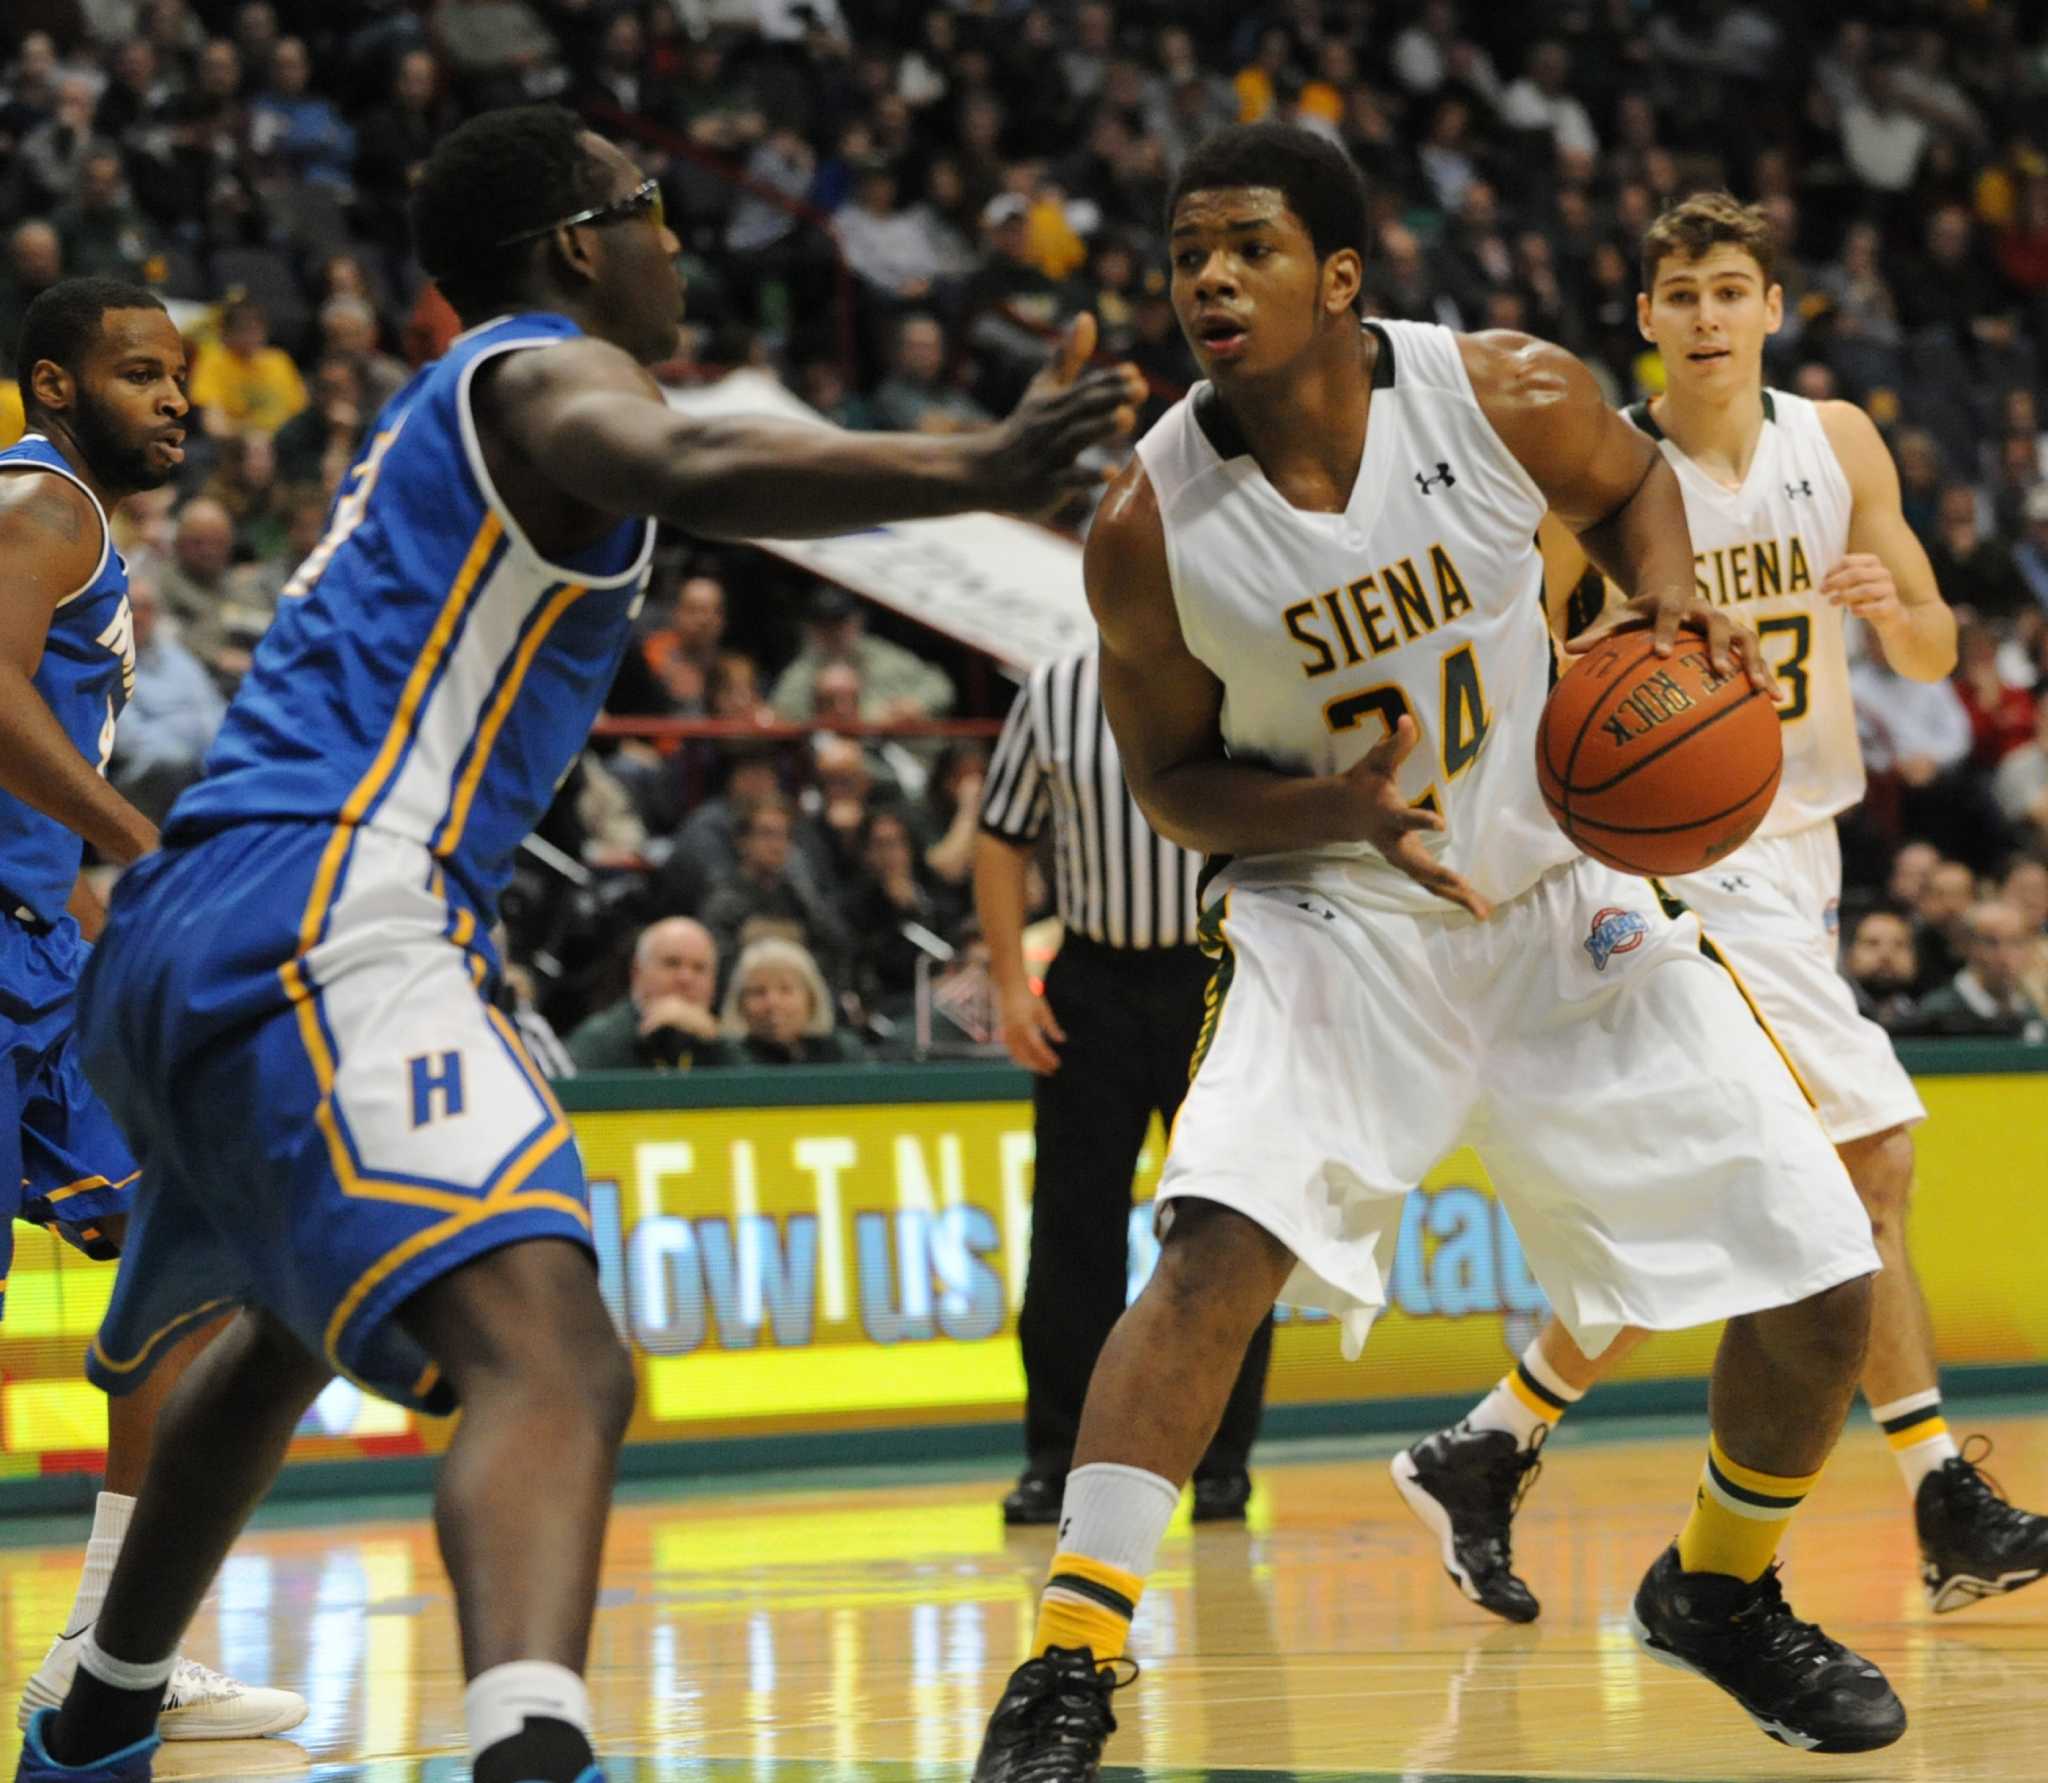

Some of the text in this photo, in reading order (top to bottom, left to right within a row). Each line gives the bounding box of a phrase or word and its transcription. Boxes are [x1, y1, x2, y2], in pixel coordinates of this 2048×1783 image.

[1281, 542, 1475, 679] SIENA
[1694, 536, 1813, 608] SIENA
[1602, 669, 1697, 747] ROCK
[404, 1050, 467, 1132] H
[855, 1203, 1005, 1342] us
